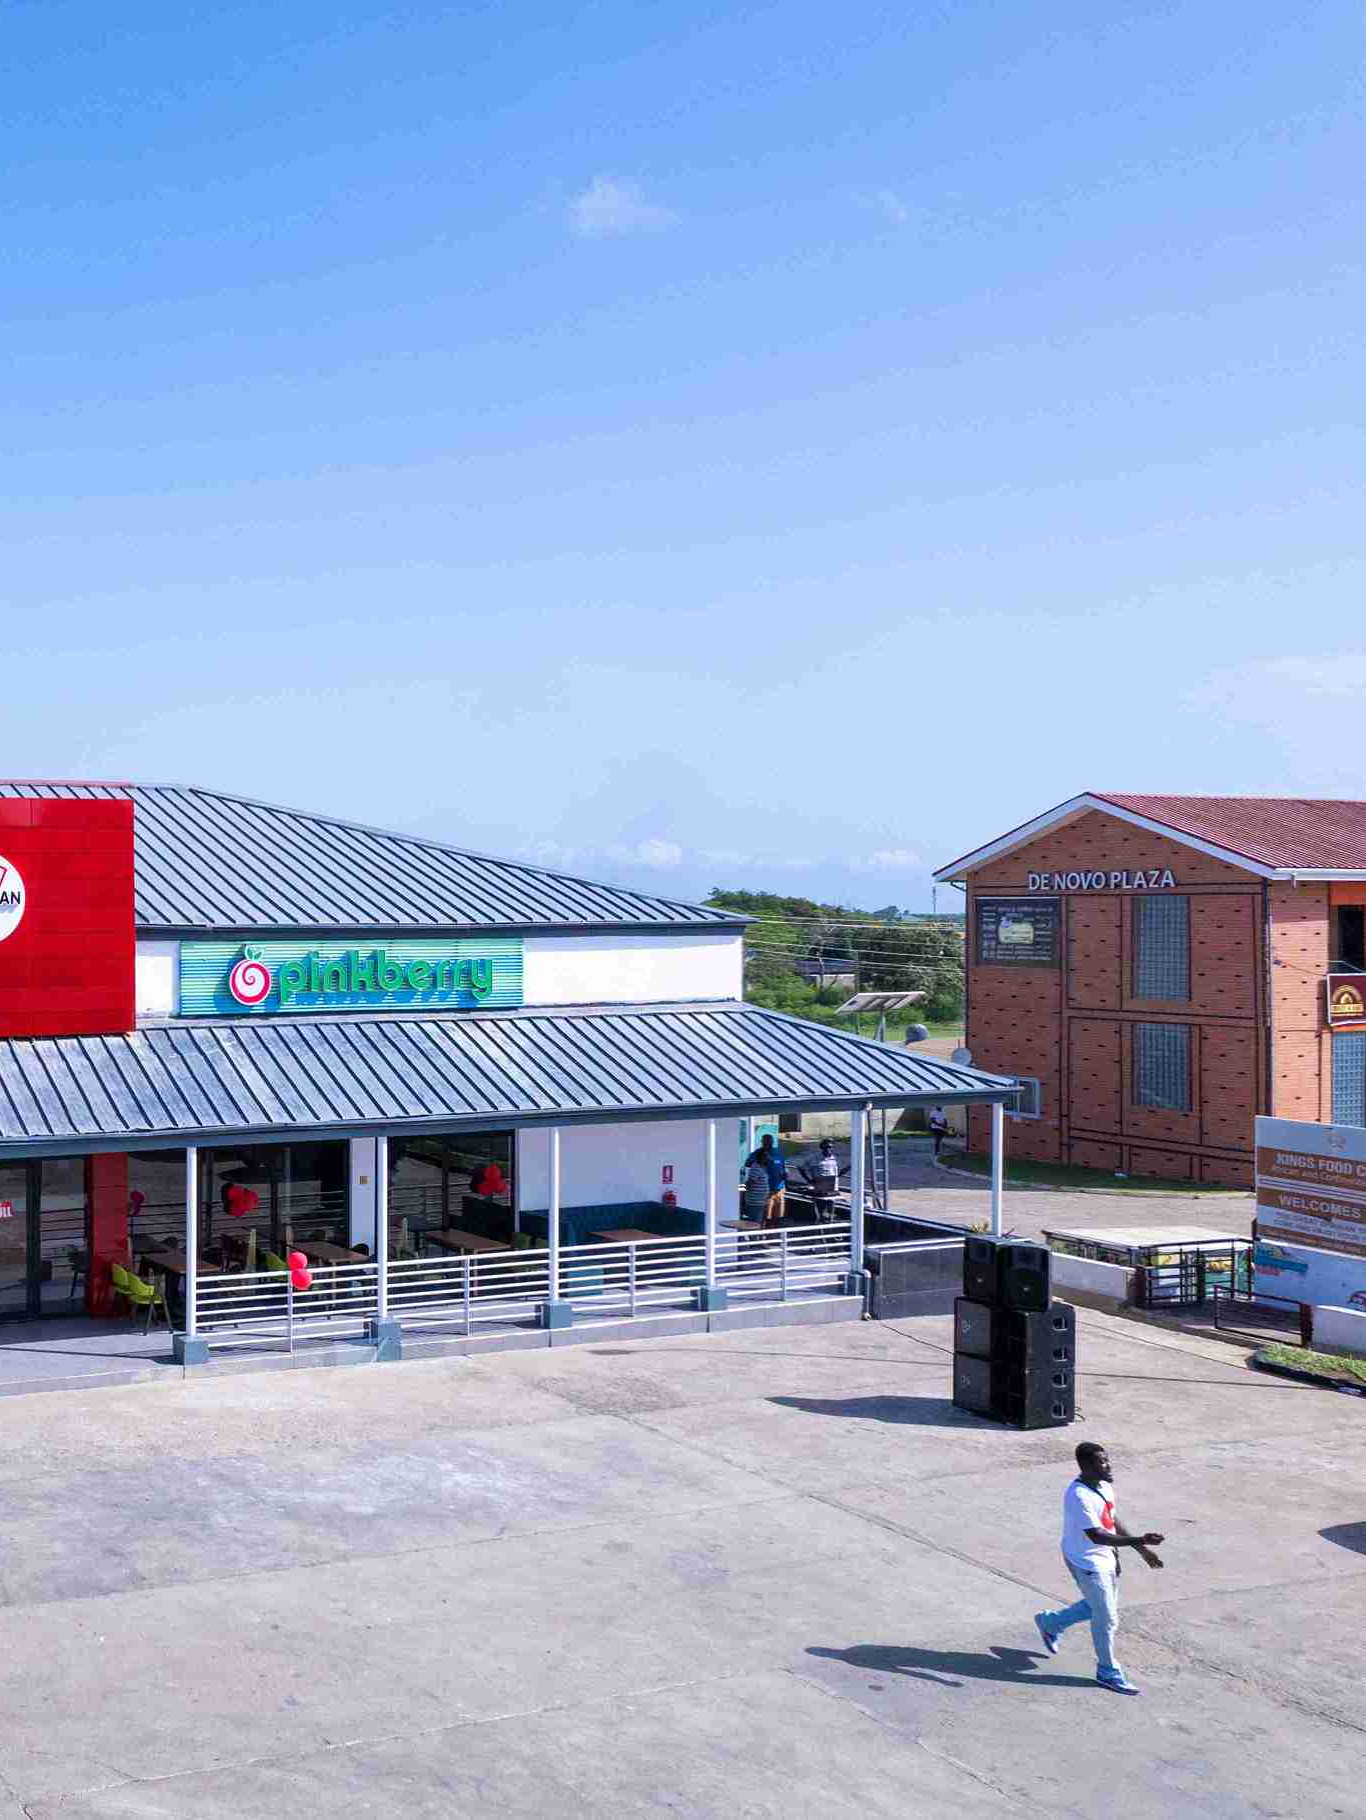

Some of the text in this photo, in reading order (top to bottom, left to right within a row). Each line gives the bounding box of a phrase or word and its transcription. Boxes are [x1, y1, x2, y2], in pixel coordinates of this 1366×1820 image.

[1027, 869, 1176, 891] DE NOVO PLAZA
[280, 949, 493, 1004] pinkberry
[1275, 1152, 1314, 1168] KINGS
[1319, 1160, 1353, 1175] FOOD
[1278, 1194, 1362, 1218] WELCOMES
